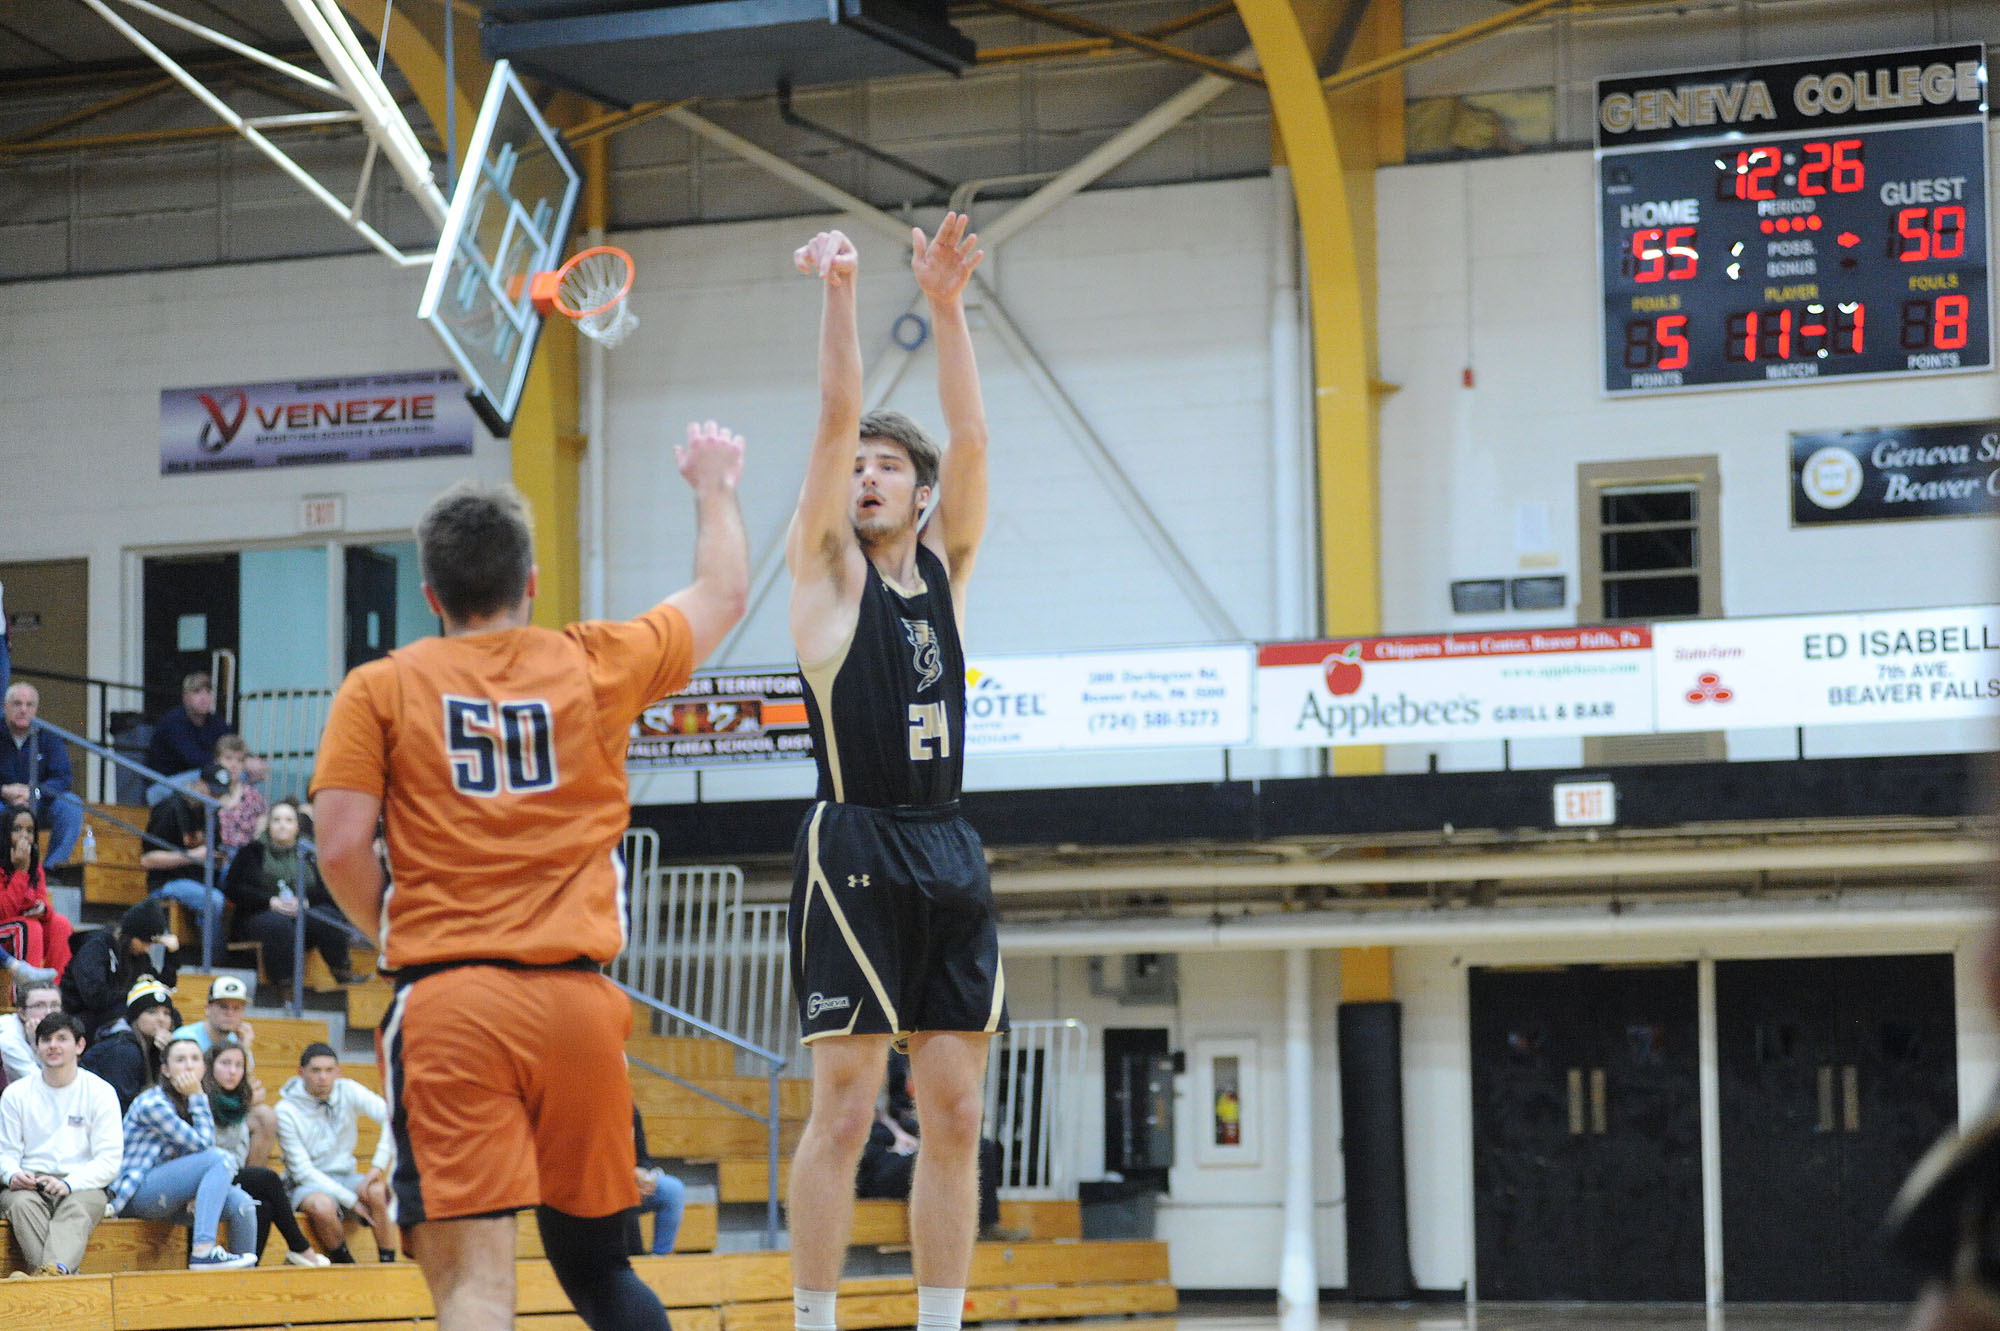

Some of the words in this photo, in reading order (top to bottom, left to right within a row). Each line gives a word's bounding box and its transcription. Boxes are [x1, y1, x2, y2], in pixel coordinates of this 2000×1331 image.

[1601, 80, 1777, 133] GENEVA
[1793, 62, 1981, 115] COLLEGE
[1735, 139, 1865, 200] 12:26
[1880, 177, 1967, 206] GUEST
[1620, 198, 1700, 228] HOME
[1757, 197, 1816, 217] PERIOD
[1899, 206, 1966, 262] 50
[1632, 226, 1698, 283] 55
[1766, 258, 1817, 278] BONUS
[1764, 283, 1818, 302] PLAYER
[1909, 275, 1959, 291] FOULS
[1934, 294, 1969, 349] 8
[1656, 315, 1690, 370] 5
[1908, 353, 1960, 369] POINTS
[256, 394, 435, 432] VENEZIE
[1871, 439, 1970, 469] Geneva
[1884, 473, 1981, 503] Beaver
[1804, 633, 1848, 659] ED
[1860, 624, 2000, 657] ISABELL
[716, 676, 803, 694] TERRITOR
[1828, 682, 1922, 706] BEAVER
[1929, 678, 2000, 700] FALLS
[966, 693, 1047, 718] OTEL
[1296, 690, 1480, 737] Applebee's
[1493, 704, 1549, 722] GRILL
[1556, 703, 1567, 719] &
[1574, 700, 1615, 719] BAR
[908, 700, 950, 760] 24
[442, 694, 558, 798] 50
[1565, 790, 1604, 819] EXIT
